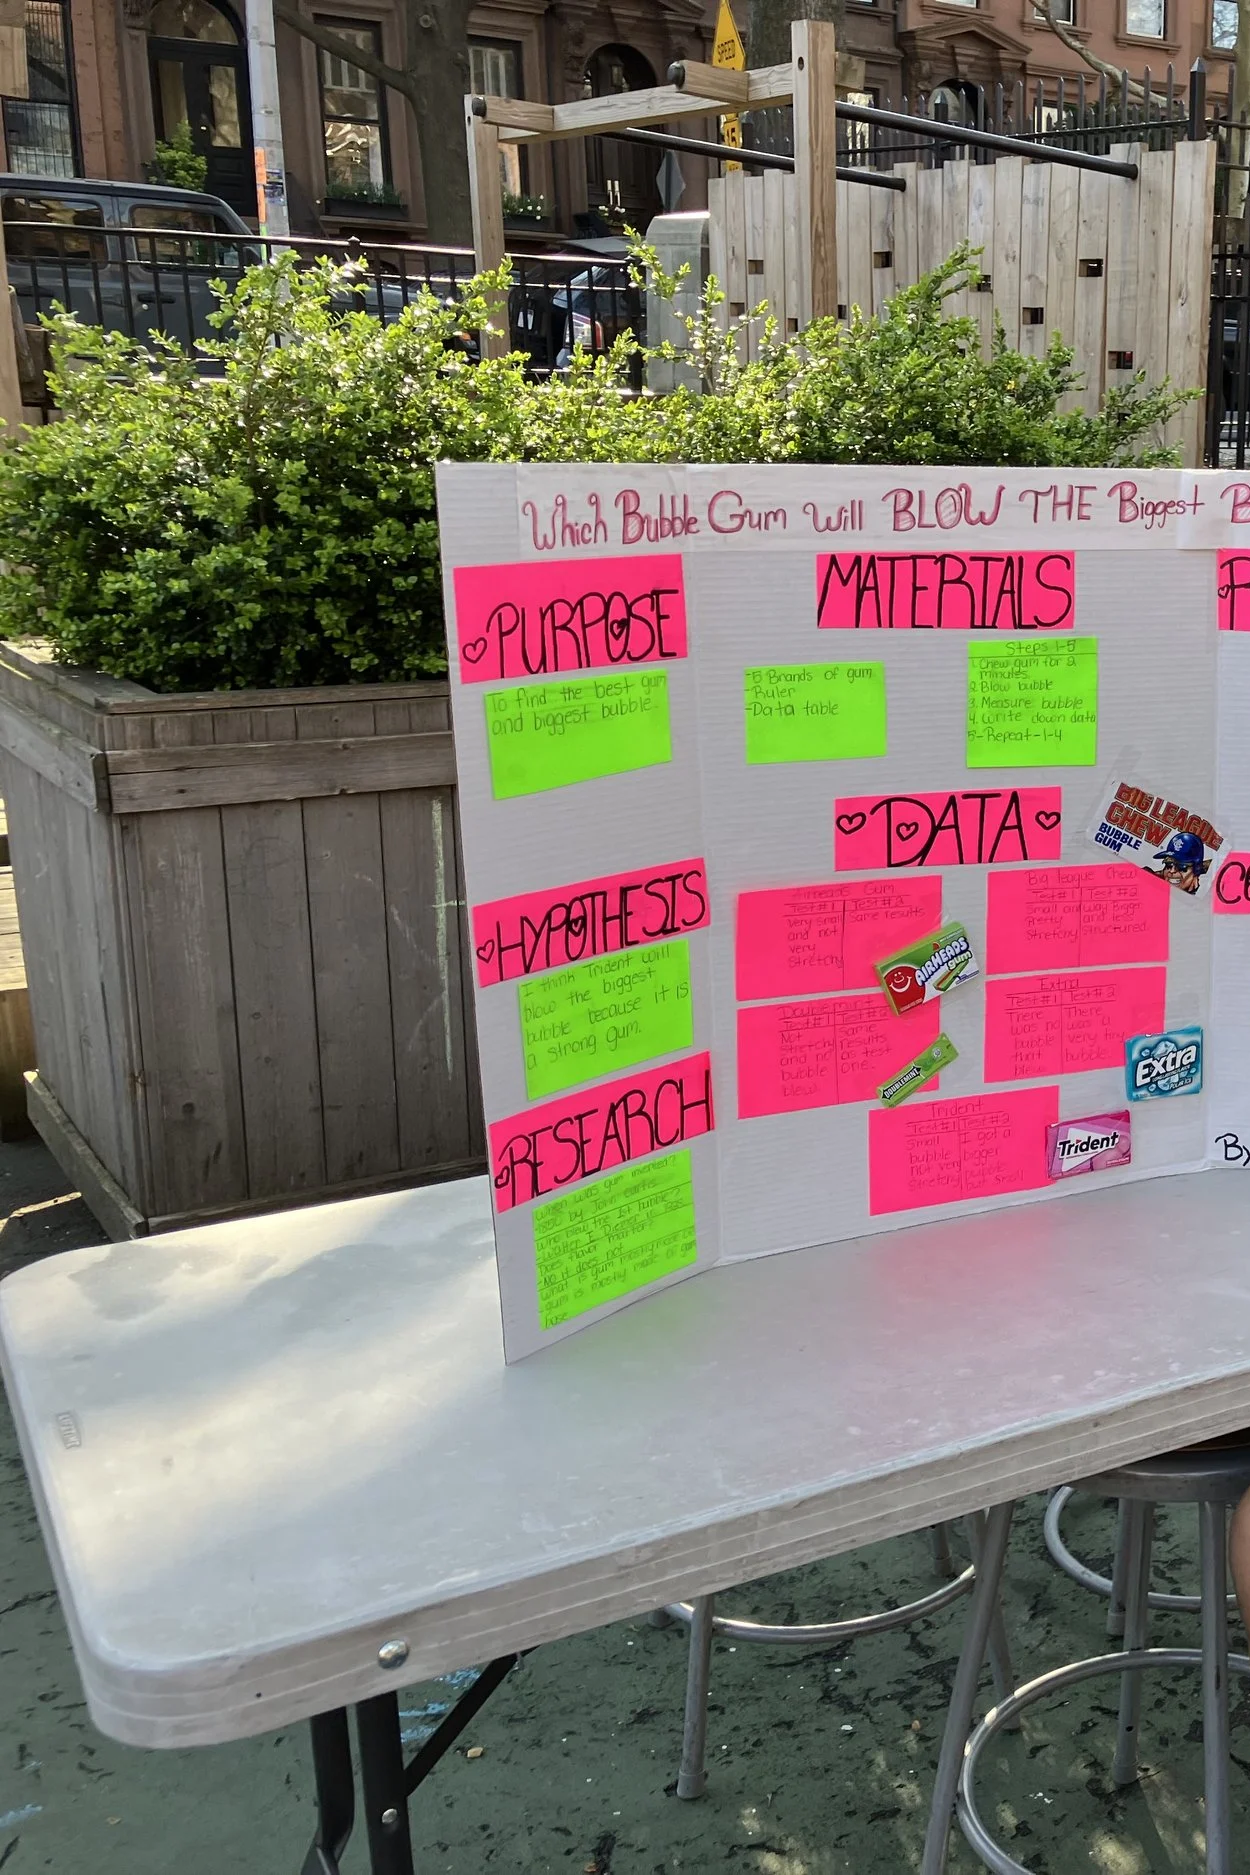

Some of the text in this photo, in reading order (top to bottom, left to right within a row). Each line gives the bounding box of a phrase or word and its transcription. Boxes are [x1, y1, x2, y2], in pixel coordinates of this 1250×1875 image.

[717, 39, 736, 63] SPEED
[522, 493, 608, 550] Which
[614, 489, 700, 545] Bubble
[708, 490, 786, 533] Gum
[882, 483, 1004, 532] BLOW
[1019, 483, 1097, 524] THE
[1108, 480, 1205, 530] Biggest
[817, 553, 1072, 629] MATERIALS
[486, 589, 679, 680] PURPOSE
[1006, 641, 1049, 657] Steps
[768, 669, 814, 685] Brands
[823, 666, 840, 681] of
[846, 667, 873, 684] gum
[980, 668, 1030, 680] minutes
[1013, 658, 1039, 674] gum
[1043, 656, 1061, 668] for
[486, 675, 668, 713] To find the best gum
[981, 680, 1010, 694] Blow
[1018, 680, 1054, 692] bubble
[803, 700, 840, 716] table
[981, 696, 1033, 709] Measure
[1041, 696, 1084, 710] bubble
[1031, 712, 1067, 724] down
[492, 716, 524, 737] and
[533, 708, 590, 737] biggest
[869, 790, 1029, 868] DATA
[1105, 801, 1172, 848] CHEW
[1114, 782, 1224, 852] BIG LEAGUE
[1094, 832, 1123, 853] GUM
[1098, 821, 1143, 851] BUBBLE
[496, 869, 706, 982] HYPOTHESIS
[540, 973, 575, 992] think
[582, 953, 634, 979] Trident
[641, 944, 670, 963] will
[915, 936, 970, 987] AIRHEADS
[946, 951, 973, 971] gum
[523, 966, 656, 1024] blow the biggest
[1037, 977, 1080, 992] Extra
[587, 996, 642, 1024] because
[654, 984, 671, 1004] it
[675, 981, 690, 1000] is
[526, 1053, 538, 1071] a
[547, 1034, 597, 1064] strong
[1135, 1044, 1198, 1088] Extra
[884, 1067, 920, 1099] DOUBLEMINT
[497, 1068, 711, 1208] RESEARCH
[1058, 1132, 1119, 1157] Trident
[568, 1206, 582, 1224] by
